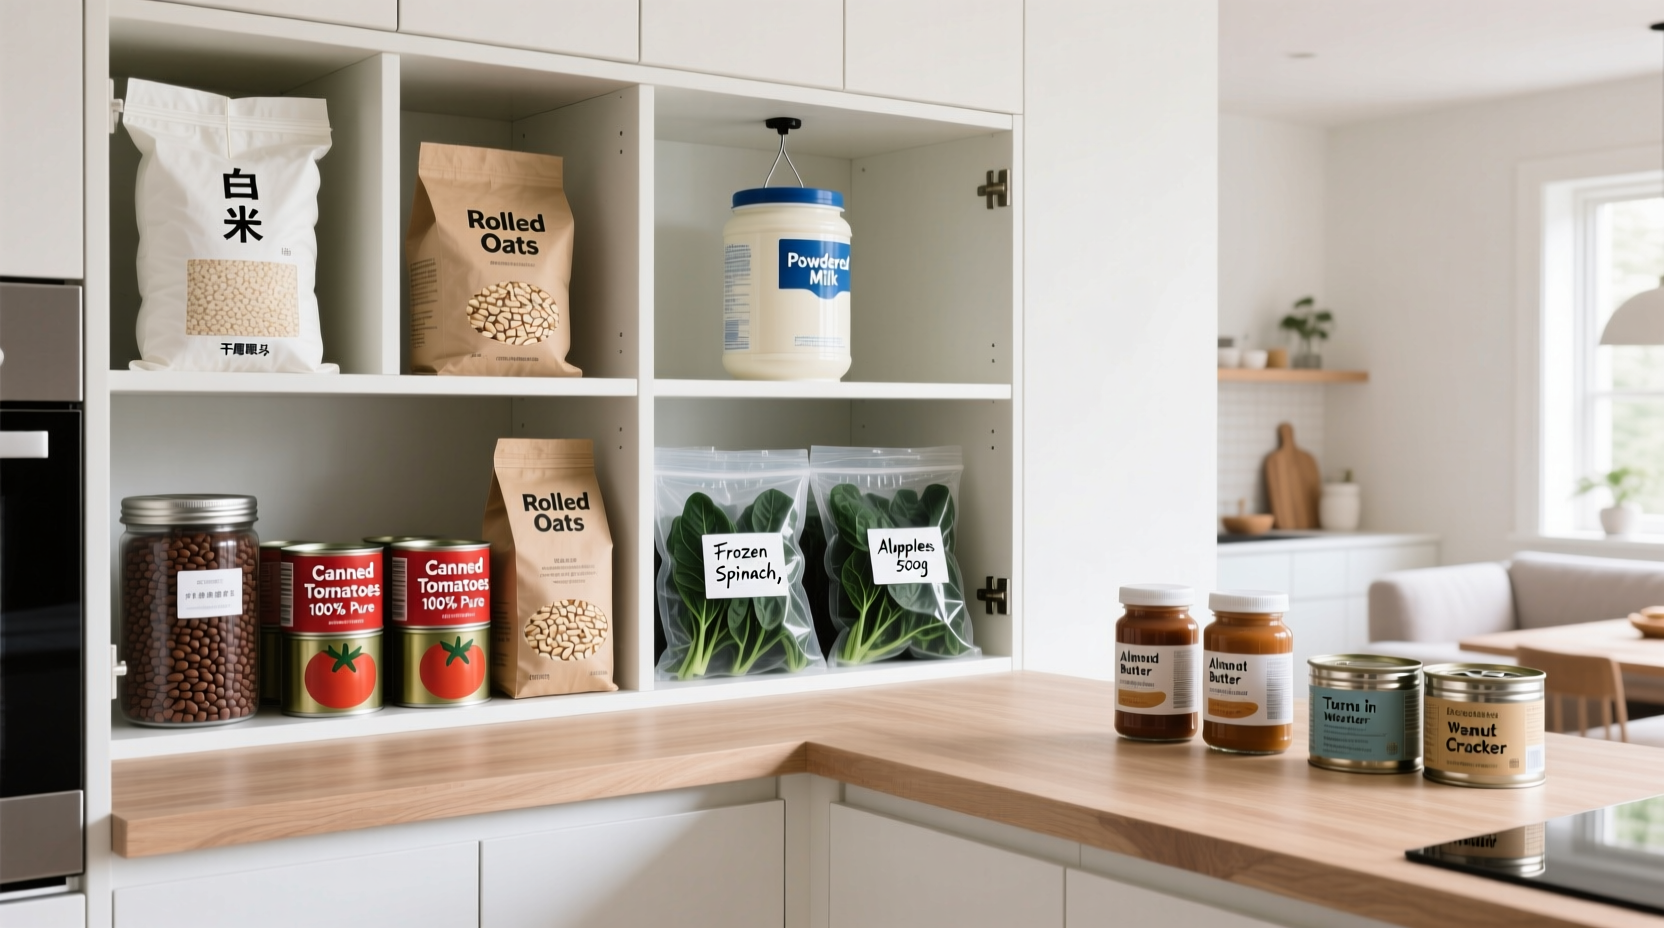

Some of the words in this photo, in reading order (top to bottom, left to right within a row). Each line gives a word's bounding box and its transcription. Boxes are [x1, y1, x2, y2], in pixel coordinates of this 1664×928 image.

[223, 168, 263, 243] 白米
[467, 209, 546, 233] Rolled
[480, 232, 539, 256] Oats
[809, 269, 838, 287] Milk
[522, 492, 590, 512] Rolled
[533, 513, 585, 533] Oats
[714, 541, 768, 561] Frozen
[312, 561, 375, 582] Canned
[425, 557, 484, 577] Canned
[716, 562, 782, 589] Spinach,
[896, 559, 928, 577] 500g
[417, 577, 490, 594] Tomatoes
[309, 602, 346, 617] 100%
[422, 596, 458, 611] 100%
[460, 595, 485, 609] Pure
[1120, 663, 1152, 676] Butter
[1209, 671, 1242, 685] Butter
[1365, 699, 1376, 713] in
[1446, 737, 1508, 754] Cracker
